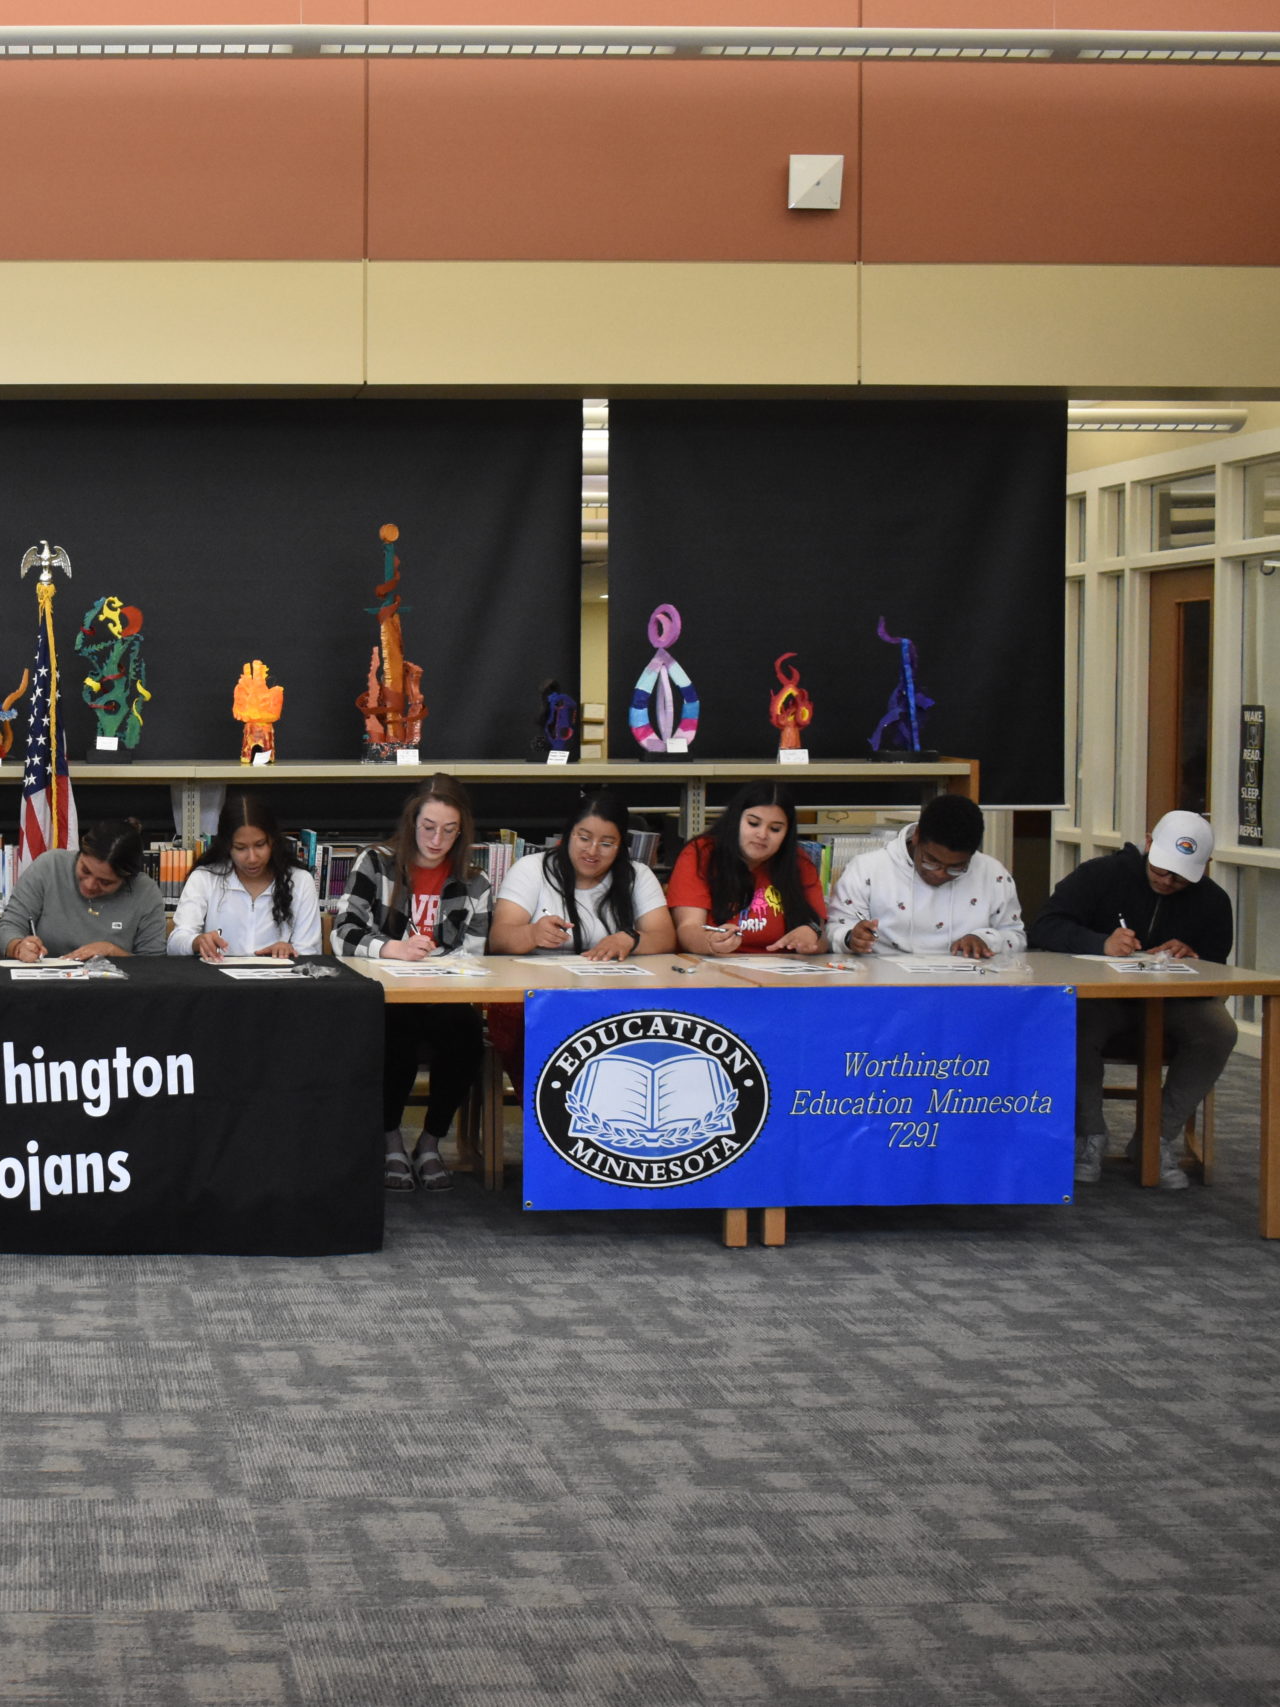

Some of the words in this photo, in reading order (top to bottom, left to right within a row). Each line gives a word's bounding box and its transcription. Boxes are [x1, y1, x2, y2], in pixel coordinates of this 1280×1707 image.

[740, 917, 767, 932] DRIP
[556, 1016, 751, 1076] EDUCATION
[844, 1051, 990, 1079] Worthington
[788, 1090, 913, 1115] Education
[925, 1088, 1052, 1114] Minnesota
[888, 1122, 941, 1148] 7291
[569, 1136, 740, 1181] MINNESOTA
